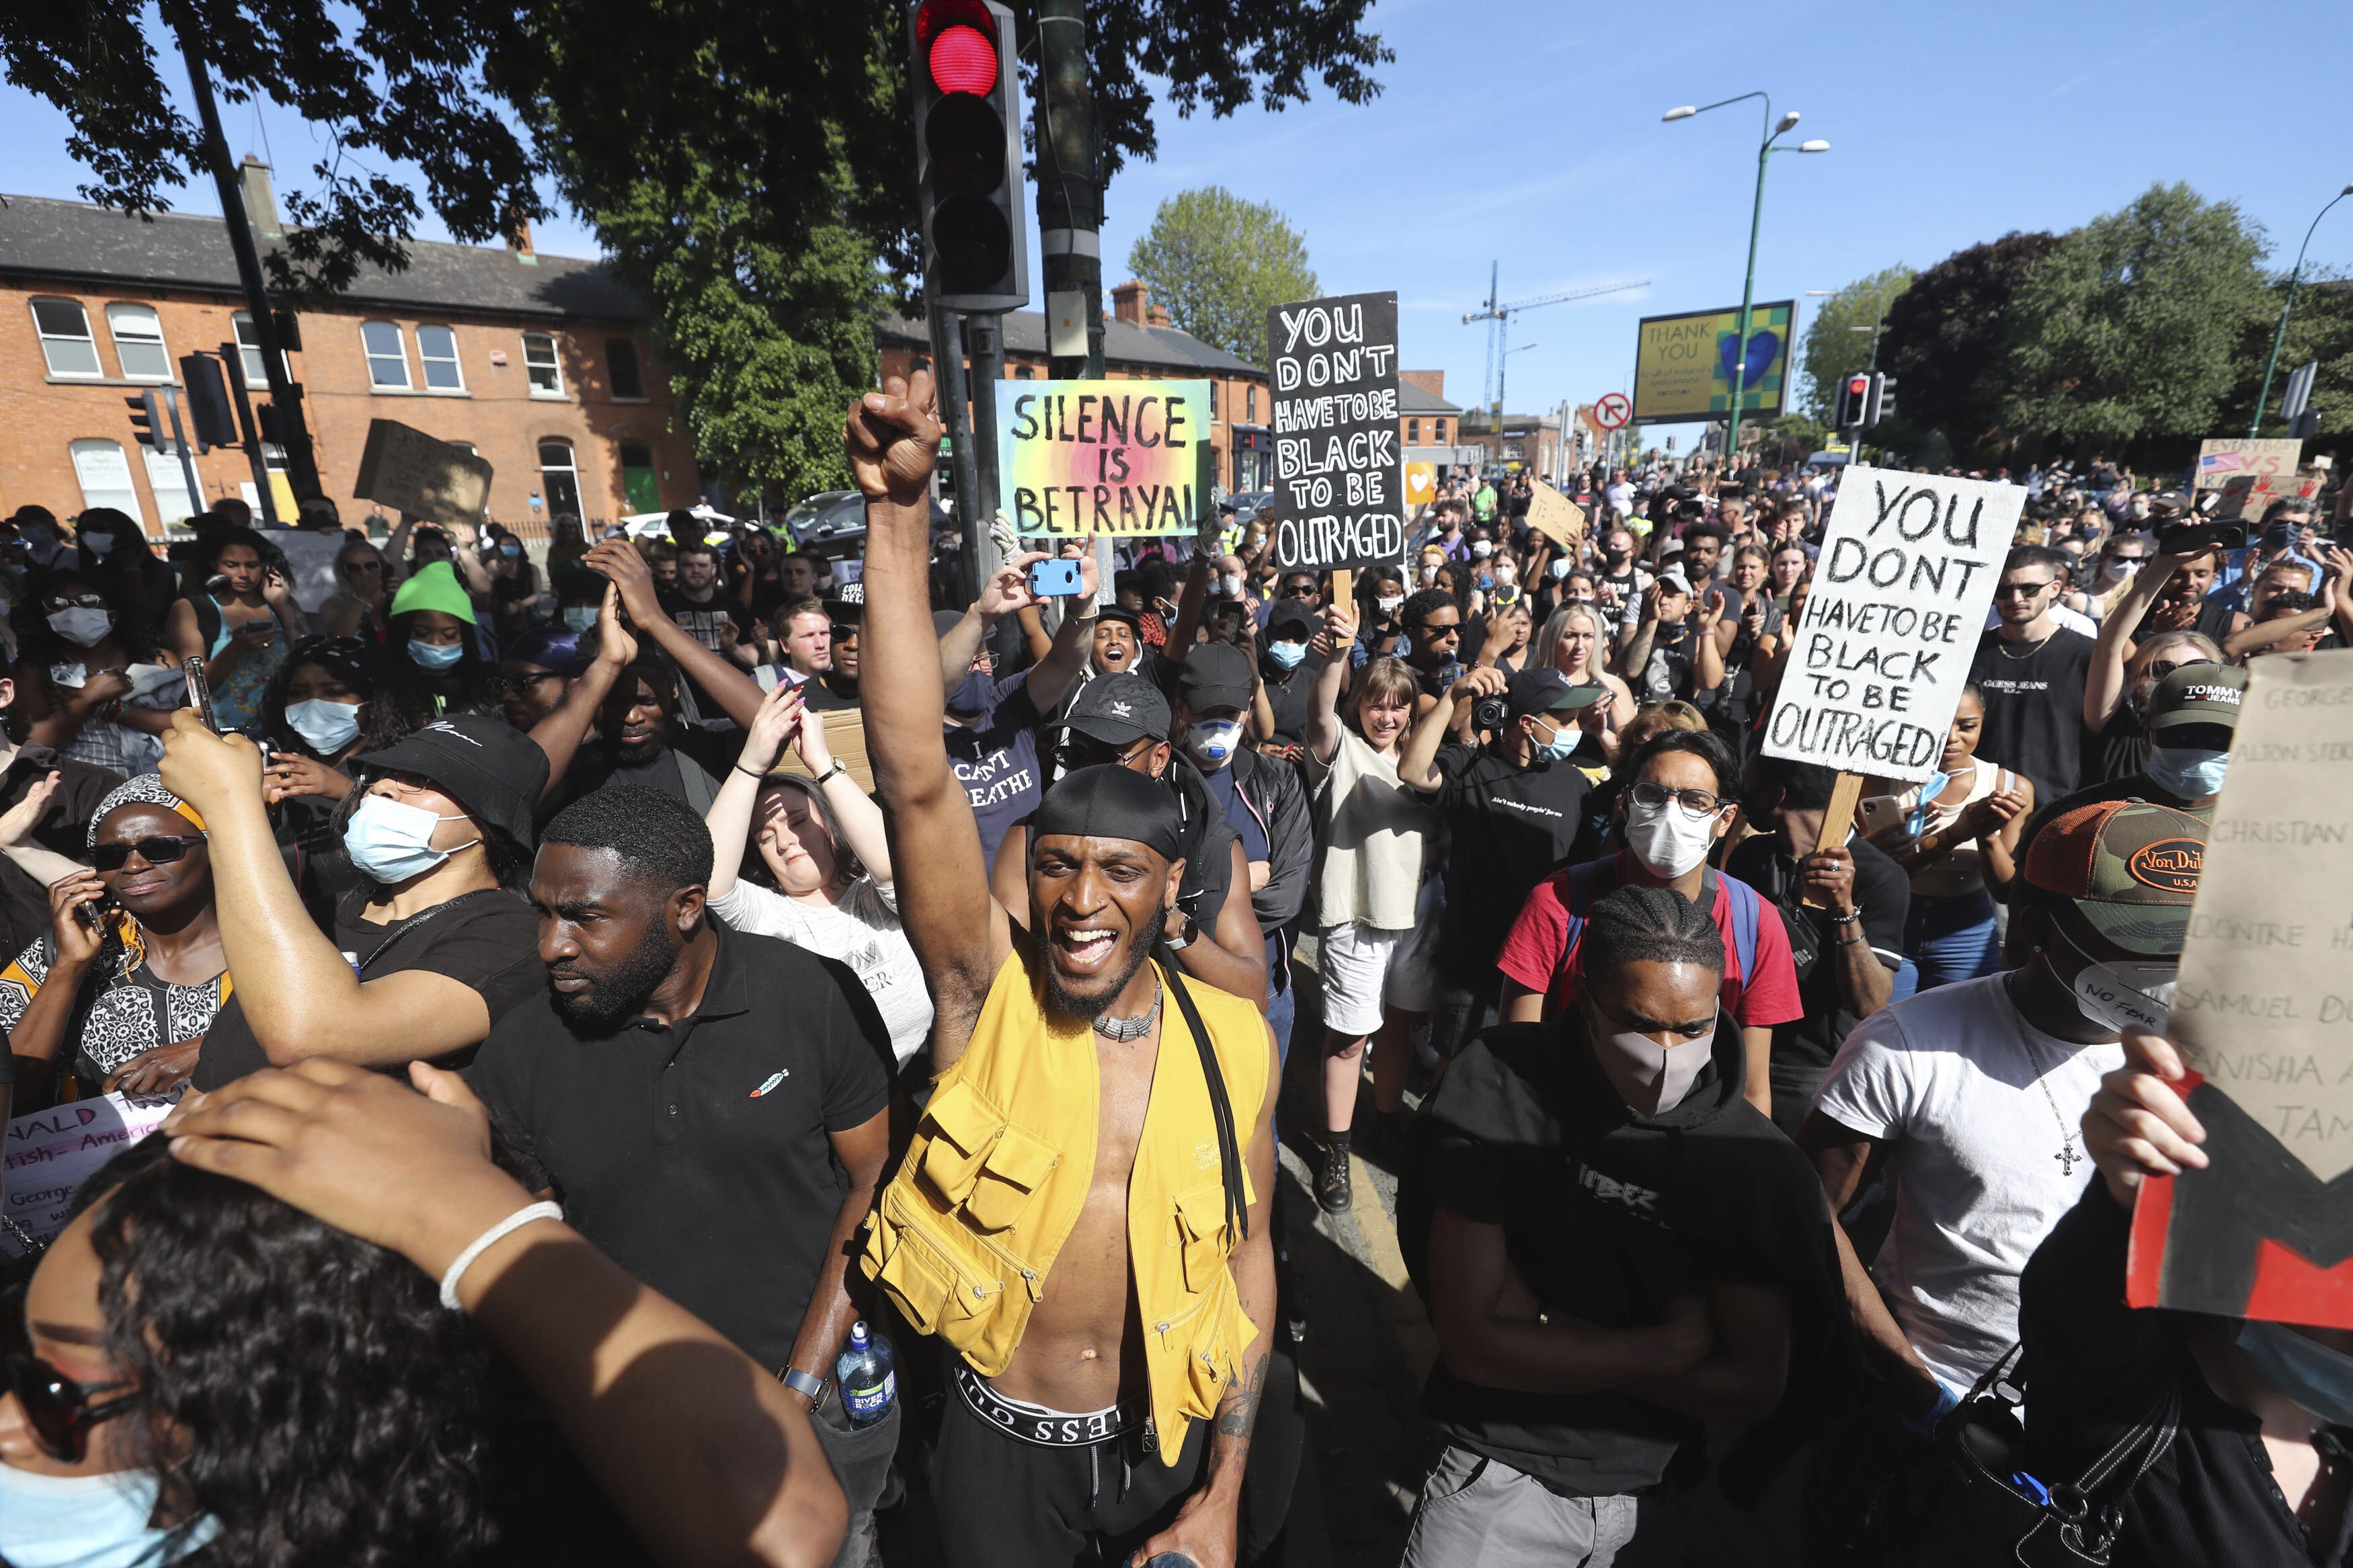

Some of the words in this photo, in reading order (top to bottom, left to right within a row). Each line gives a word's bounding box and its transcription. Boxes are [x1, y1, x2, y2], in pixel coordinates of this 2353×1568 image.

[1280, 303, 1363, 353] YOU
[1650, 322, 1710, 344] THANK
[1659, 342, 1699, 361] YOU
[1277, 344, 1394, 391] DON'T
[1010, 394, 1186, 448] SILENCE
[1277, 429, 1395, 479] BLACK
[2210, 439, 2299, 452] EVERYBODY
[1099, 447, 1131, 484] IS
[2240, 456, 2281, 474] VS
[1289, 477, 1333, 509] TO
[1346, 472, 1385, 507] BE
[1014, 483, 1197, 533] BETRAYAL
[1866, 479, 1985, 550] YOU
[1278, 513, 1402, 567] OUTRAGED
[1806, 633, 1942, 684] BLACK
[1805, 673, 1850, 700] TO
[1862, 684, 1914, 712] BE
[1983, 679, 2017, 688] GUESS
[2017, 681, 2048, 690] JEANS
[2186, 685, 2242, 698] TOMMY
[2206, 694, 2240, 706] JEANS
[2264, 686, 2353, 710] GEORGE
[1771, 702, 1948, 768] OUTRAGED!
[972, 741, 983, 759] I
[2235, 743, 2299, 763] ALTON
[965, 768, 1033, 807] EATHE
[1492, 796, 1507, 805] Ain't
[1507, 801, 1526, 811] nobody
[2212, 820, 2348, 844] CHRISTIAN
[2141, 850, 2176, 870] Von
[2176, 850, 2205, 869] Dut
[2085, 984, 2114, 1001] NO
[2176, 981, 2299, 1020] SAMUEL
[2115, 1002, 2155, 1027] FEAR
[7, 1108, 97, 1141] NALD
[10, 1184, 77, 1206] George
[854, 1392, 883, 1404] RIVER
